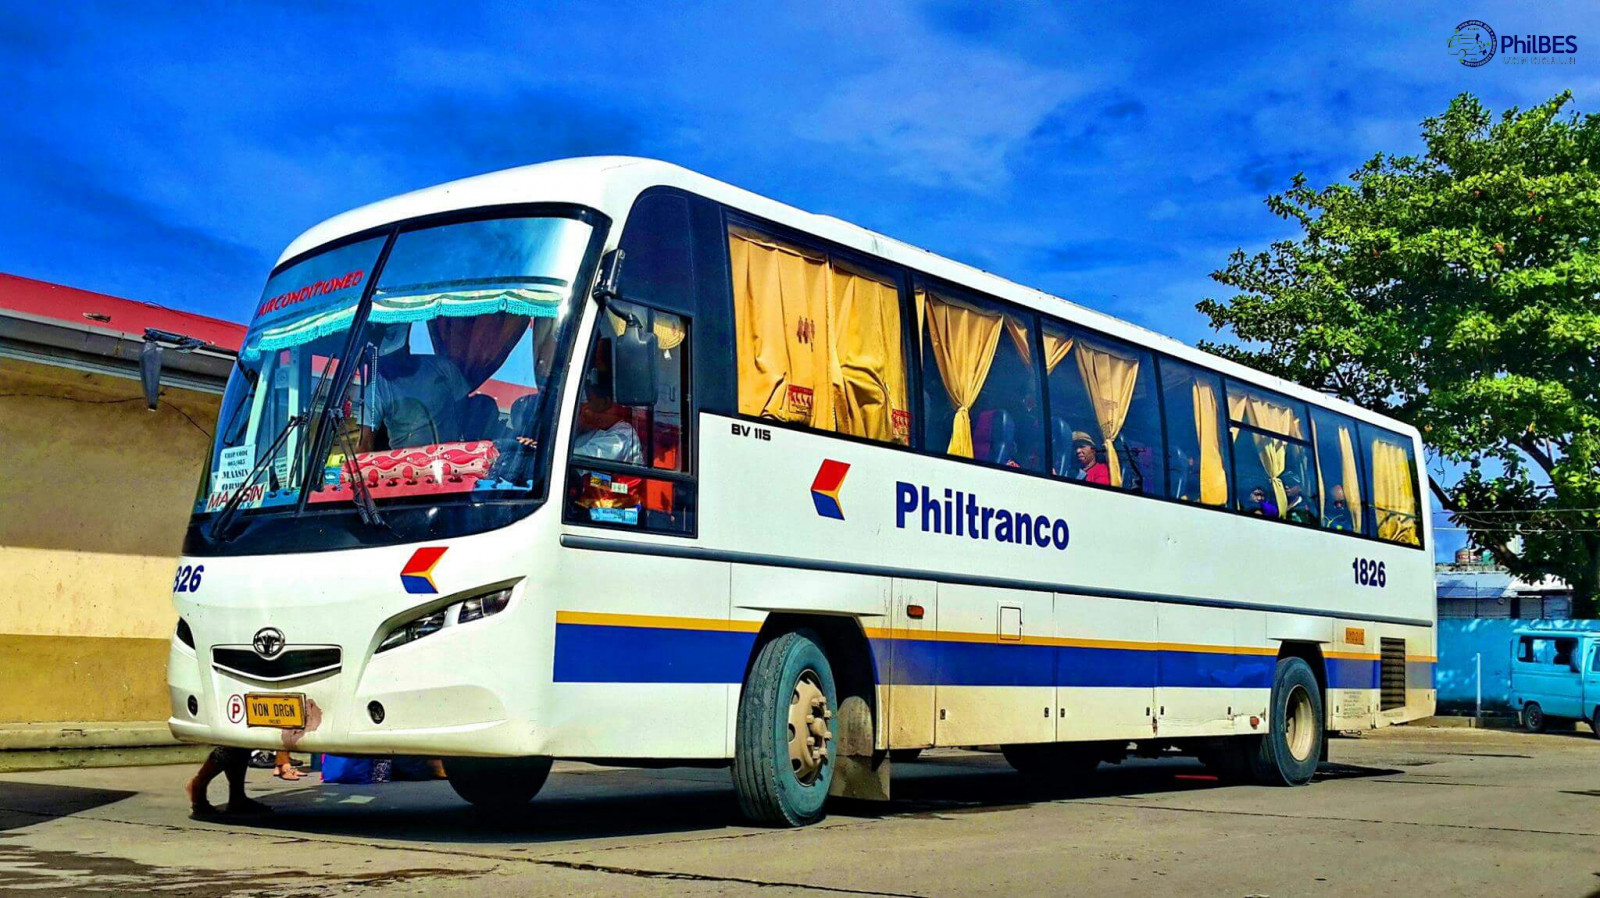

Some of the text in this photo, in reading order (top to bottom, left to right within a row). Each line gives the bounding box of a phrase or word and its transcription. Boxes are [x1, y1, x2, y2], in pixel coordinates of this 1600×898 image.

[258, 269, 364, 317] AIRCONDITIONED
[731, 423, 772, 441] BV 115
[207, 484, 265, 509] MASIN
[221, 481, 246, 491] ORM
[896, 481, 1070, 551] Philtranco
[1352, 557, 1386, 588] 1826
[232, 703, 241, 719] P
[252, 702, 296, 717] VON DRGN
